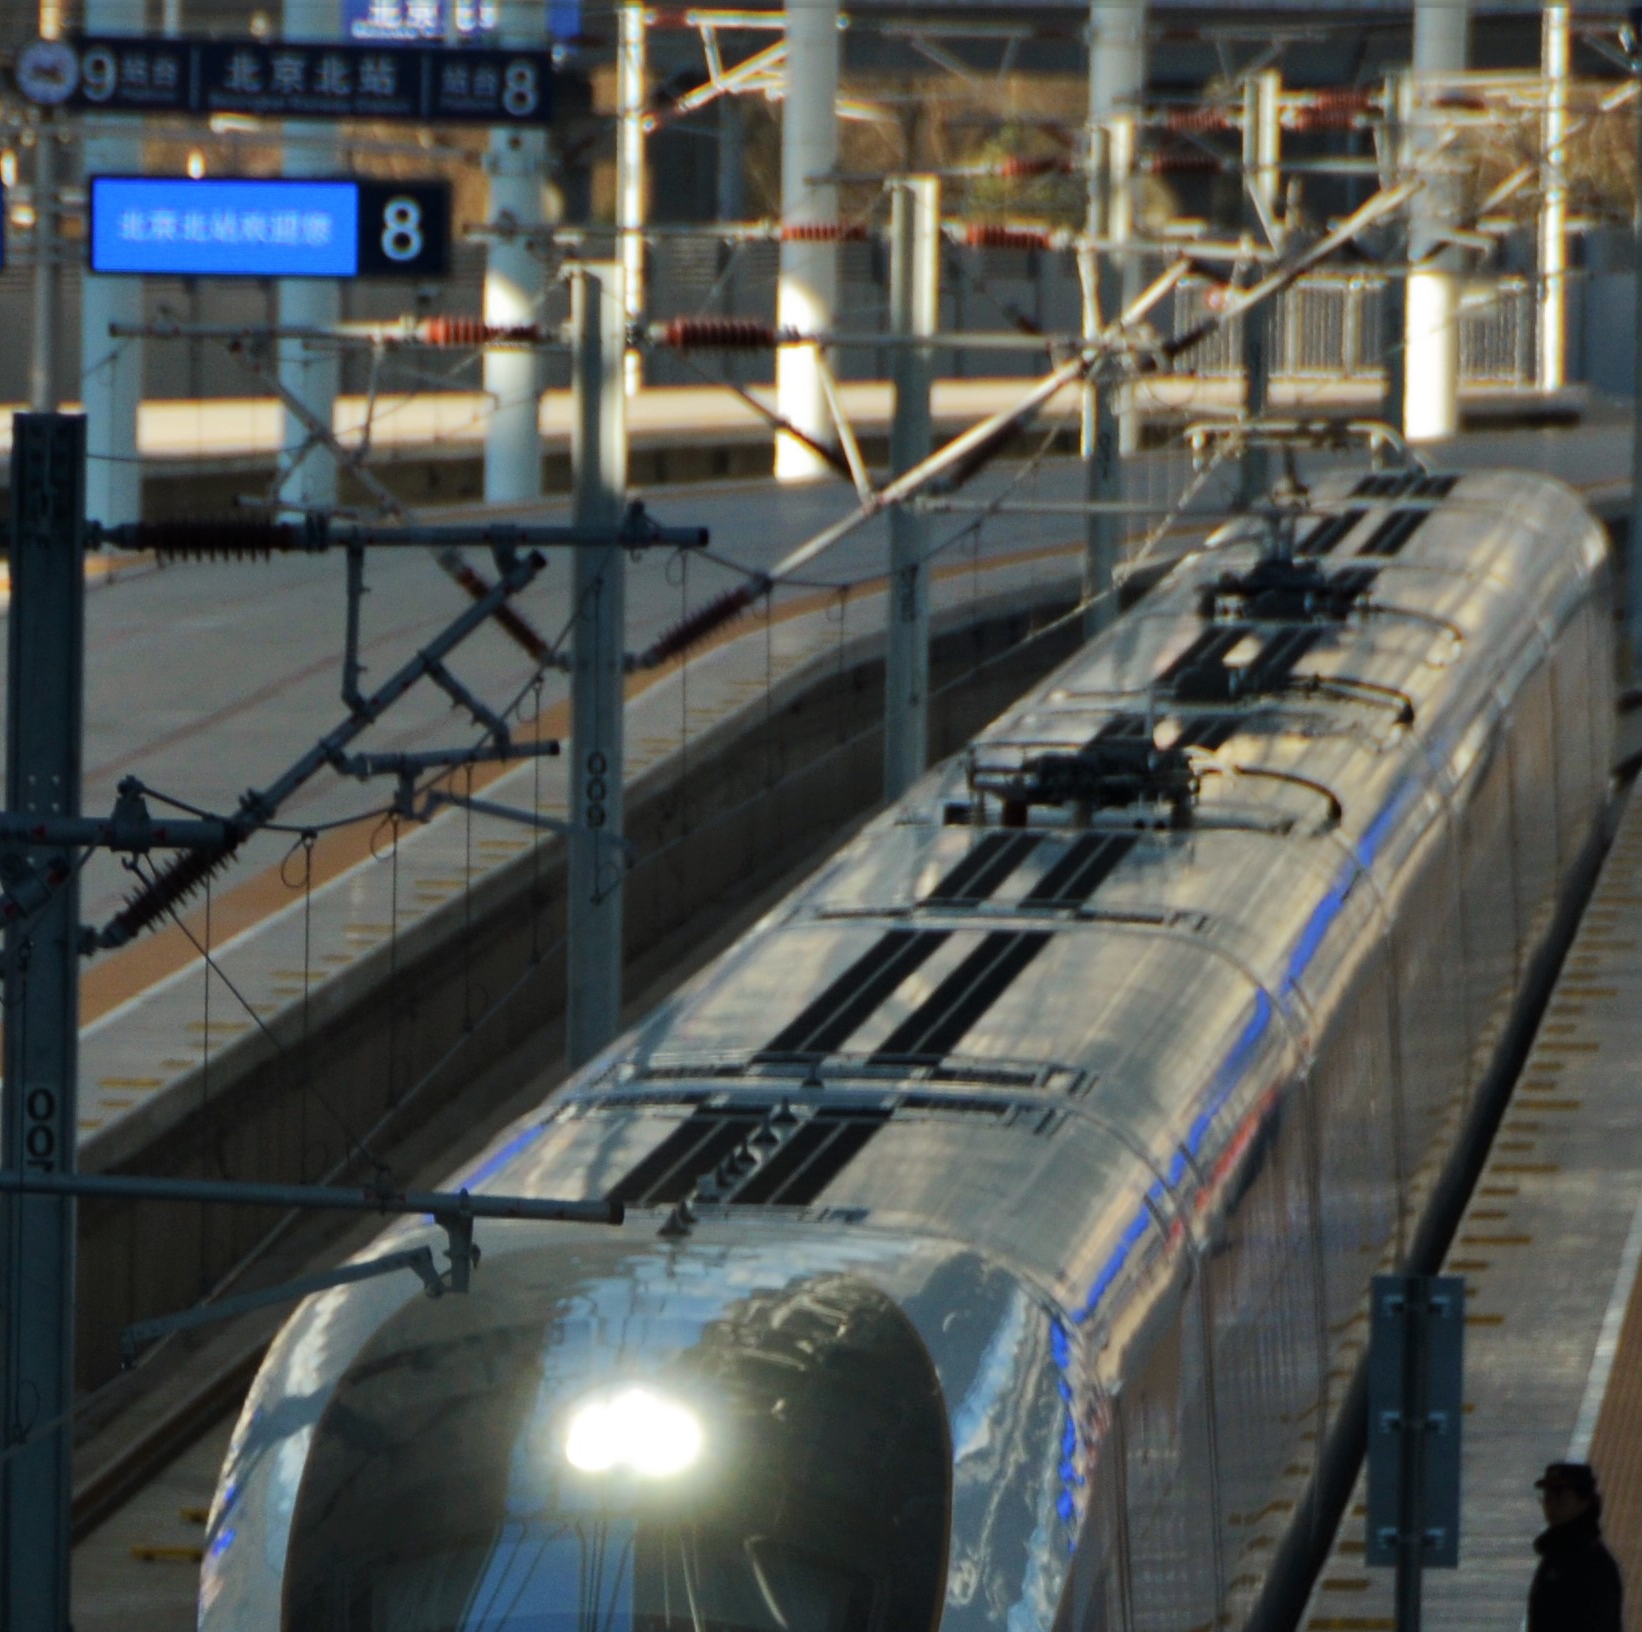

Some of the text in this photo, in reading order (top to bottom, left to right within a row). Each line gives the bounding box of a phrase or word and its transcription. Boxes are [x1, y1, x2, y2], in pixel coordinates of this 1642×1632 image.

[82, 46, 117, 101] 9
[223, 49, 398, 97] 北京北站
[502, 58, 540, 116] 8
[380, 197, 424, 262] 8
